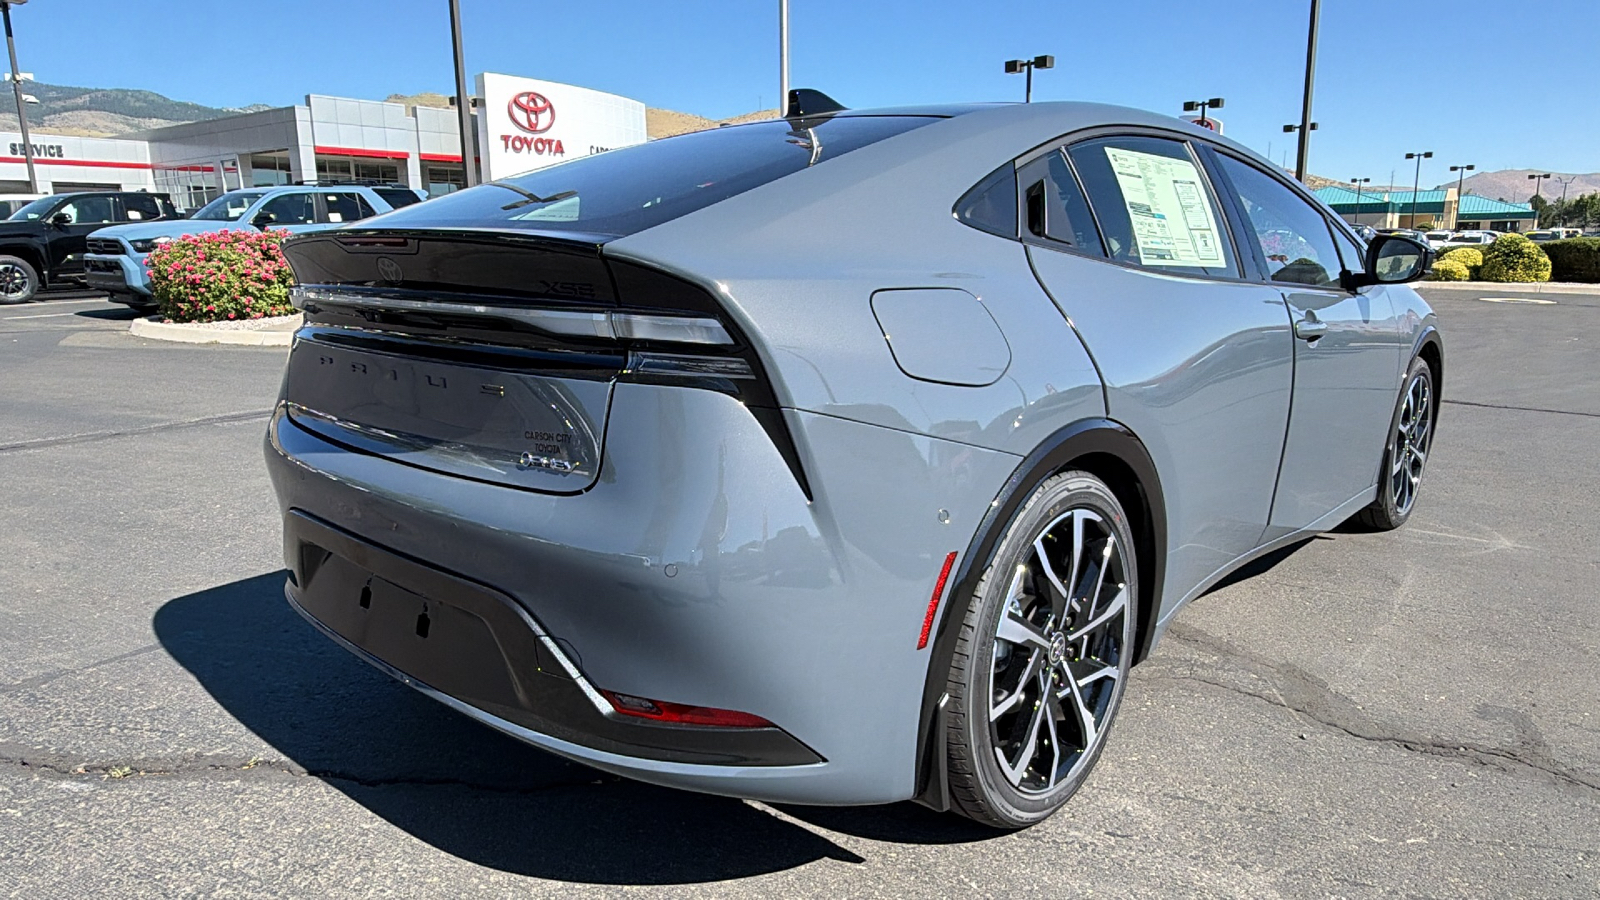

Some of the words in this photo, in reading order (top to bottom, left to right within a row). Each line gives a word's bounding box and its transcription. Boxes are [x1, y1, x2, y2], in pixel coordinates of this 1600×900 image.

[500, 134, 565, 157] TOYOTA
[540, 281, 596, 297] XSE
[524, 431, 554, 442] CARSON
[555, 433, 573, 444] CITY
[534, 443, 561, 454] TOYOTA
